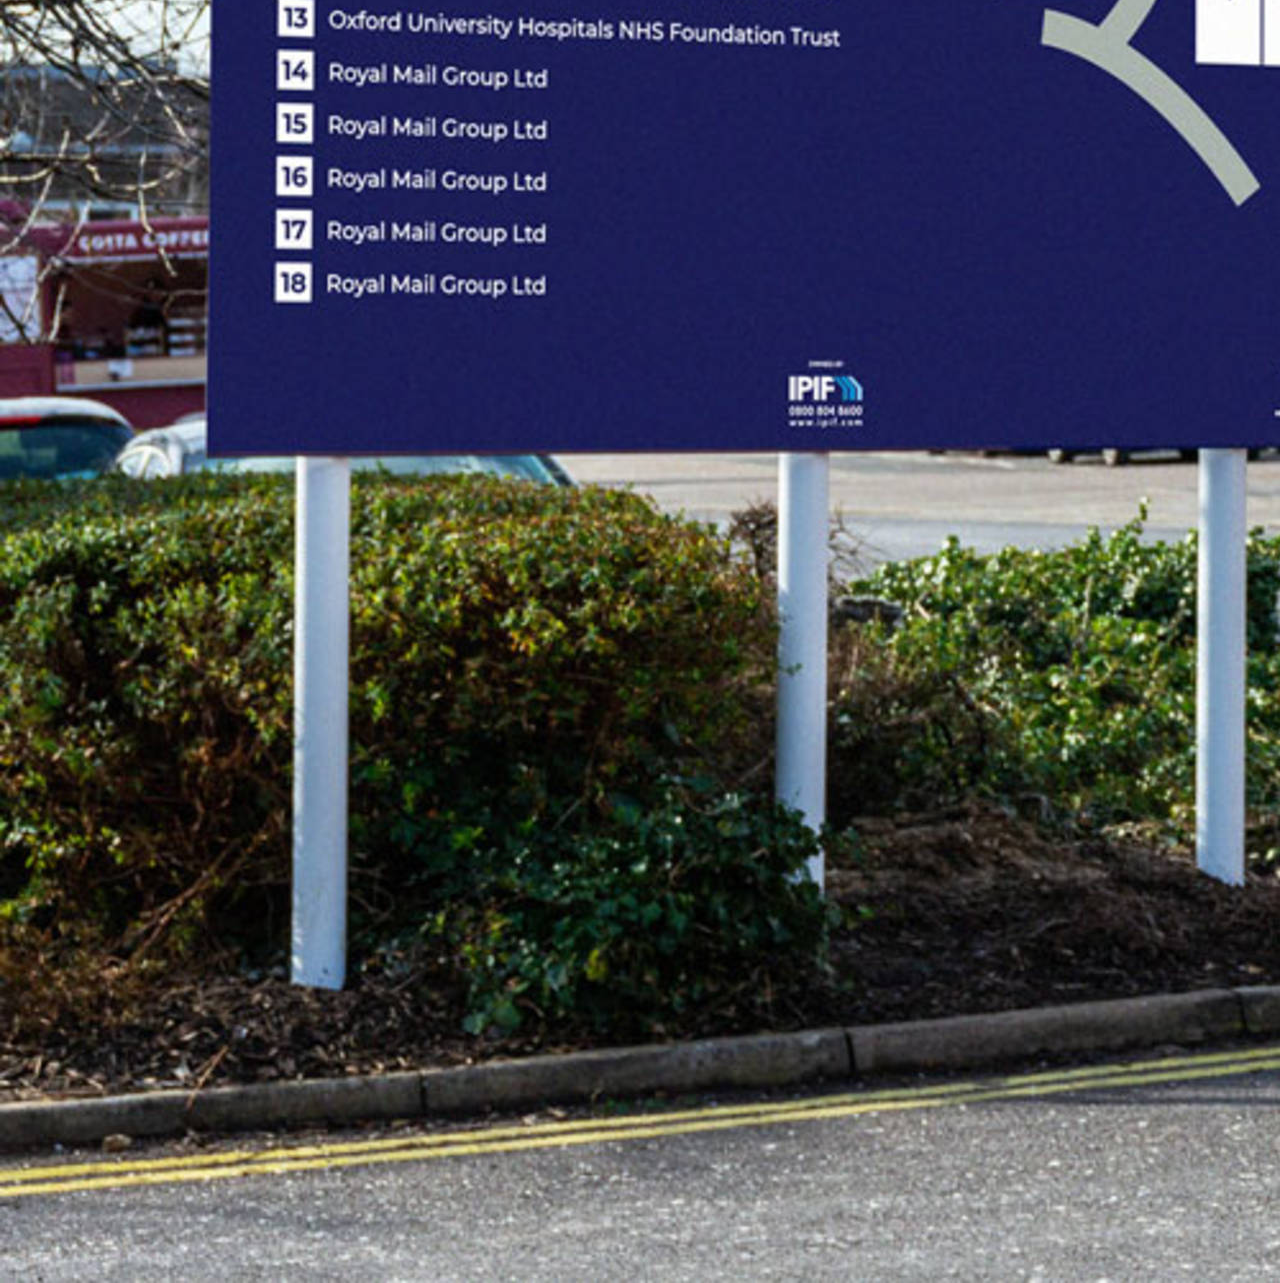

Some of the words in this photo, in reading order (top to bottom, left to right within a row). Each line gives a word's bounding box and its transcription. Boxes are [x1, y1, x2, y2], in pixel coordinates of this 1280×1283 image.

[283, 6, 308, 29] 13
[327, 9, 403, 32] Oxford
[407, 12, 514, 40] University
[517, 16, 615, 42] Hospitals
[618, 20, 665, 42] NHS
[669, 22, 786, 45] Foundation
[789, 26, 841, 48] Trust
[282, 59, 308, 81] 14
[328, 61, 388, 88] Royal
[392, 63, 437, 85] Mail
[441, 65, 510, 91] Group
[513, 68, 549, 89] Ltd
[282, 112, 308, 135] 15
[327, 114, 387, 140] Royal
[392, 116, 437, 137] Mail
[441, 117, 509, 143] Group
[513, 119, 548, 140] Ltd
[281, 165, 308, 188] 16
[327, 167, 387, 193] Royal
[391, 168, 437, 189] Mail
[440, 169, 509, 196] Group
[513, 171, 547, 192] Ltd
[79, 232, 139, 253] COSTA
[281, 219, 307, 240] 17
[327, 219, 386, 246] Royal
[391, 220, 437, 242] Mail
[440, 222, 508, 247] Group
[512, 223, 547, 244] Ltd
[280, 271, 307, 294] 18
[326, 273, 386, 299] Royal
[390, 273, 436, 295] Mail
[439, 274, 508, 300] Group
[511, 275, 547, 296] Ltd
[788, 375, 836, 402] IPIF
